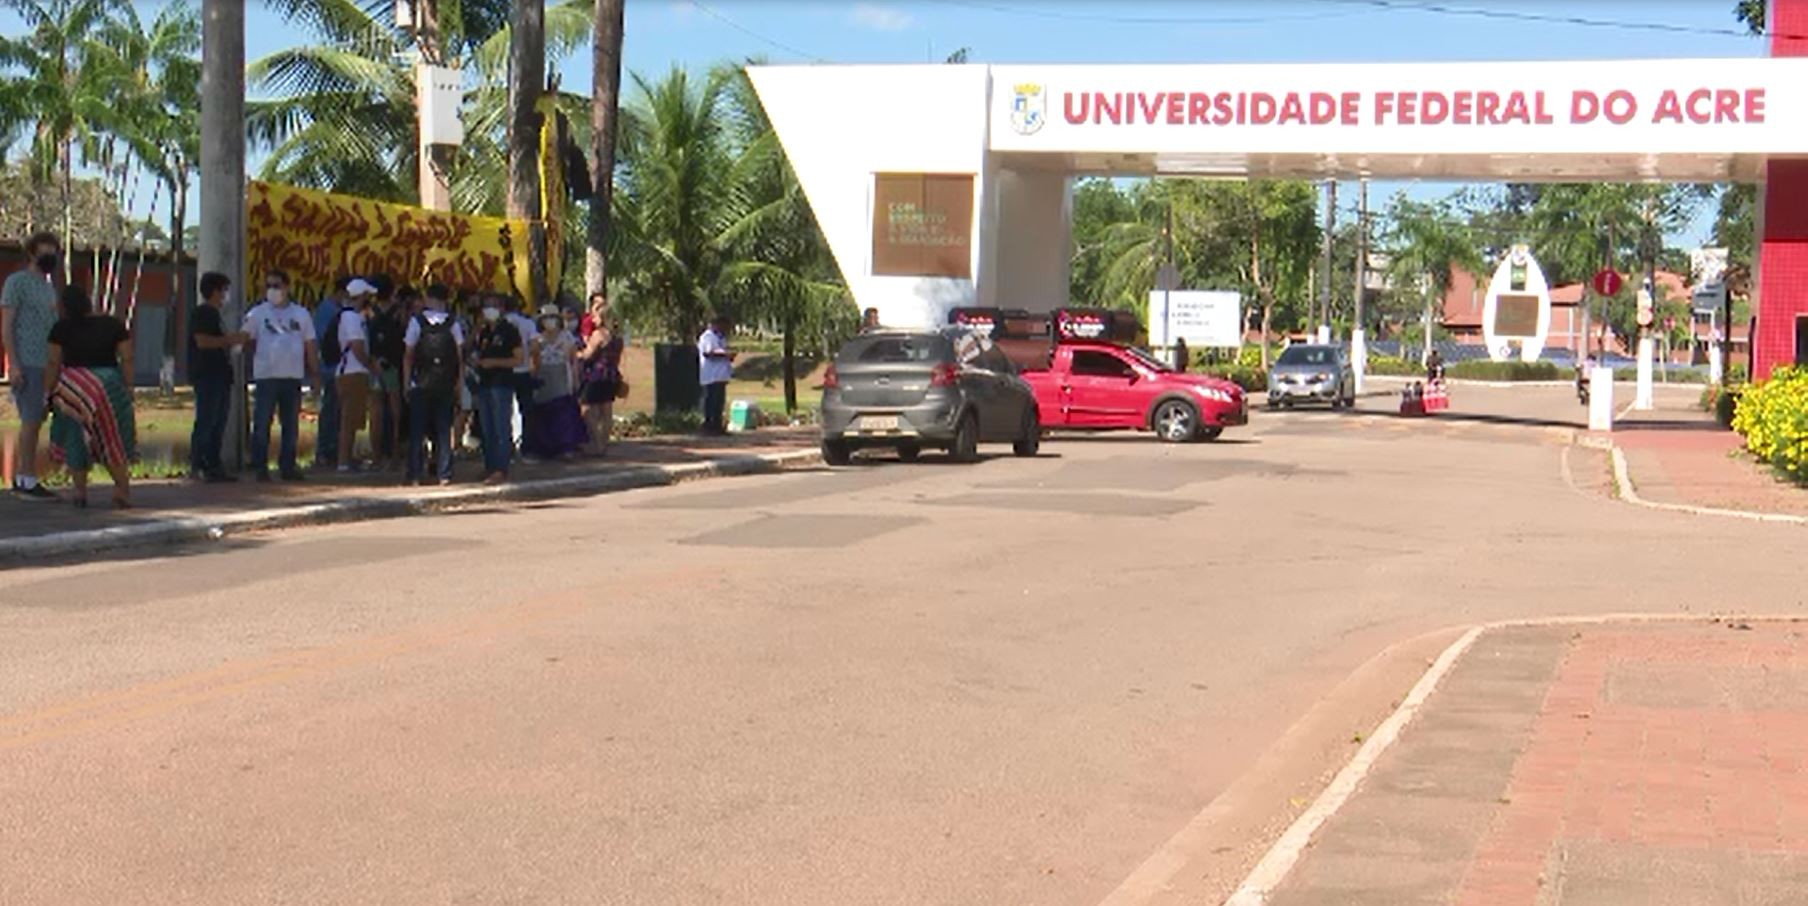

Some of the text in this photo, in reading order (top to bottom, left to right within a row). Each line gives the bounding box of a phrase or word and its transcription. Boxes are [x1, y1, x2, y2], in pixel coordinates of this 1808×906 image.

[1063, 88, 1766, 126] UNIVERSIDADE FEDERAL DO ACRE
